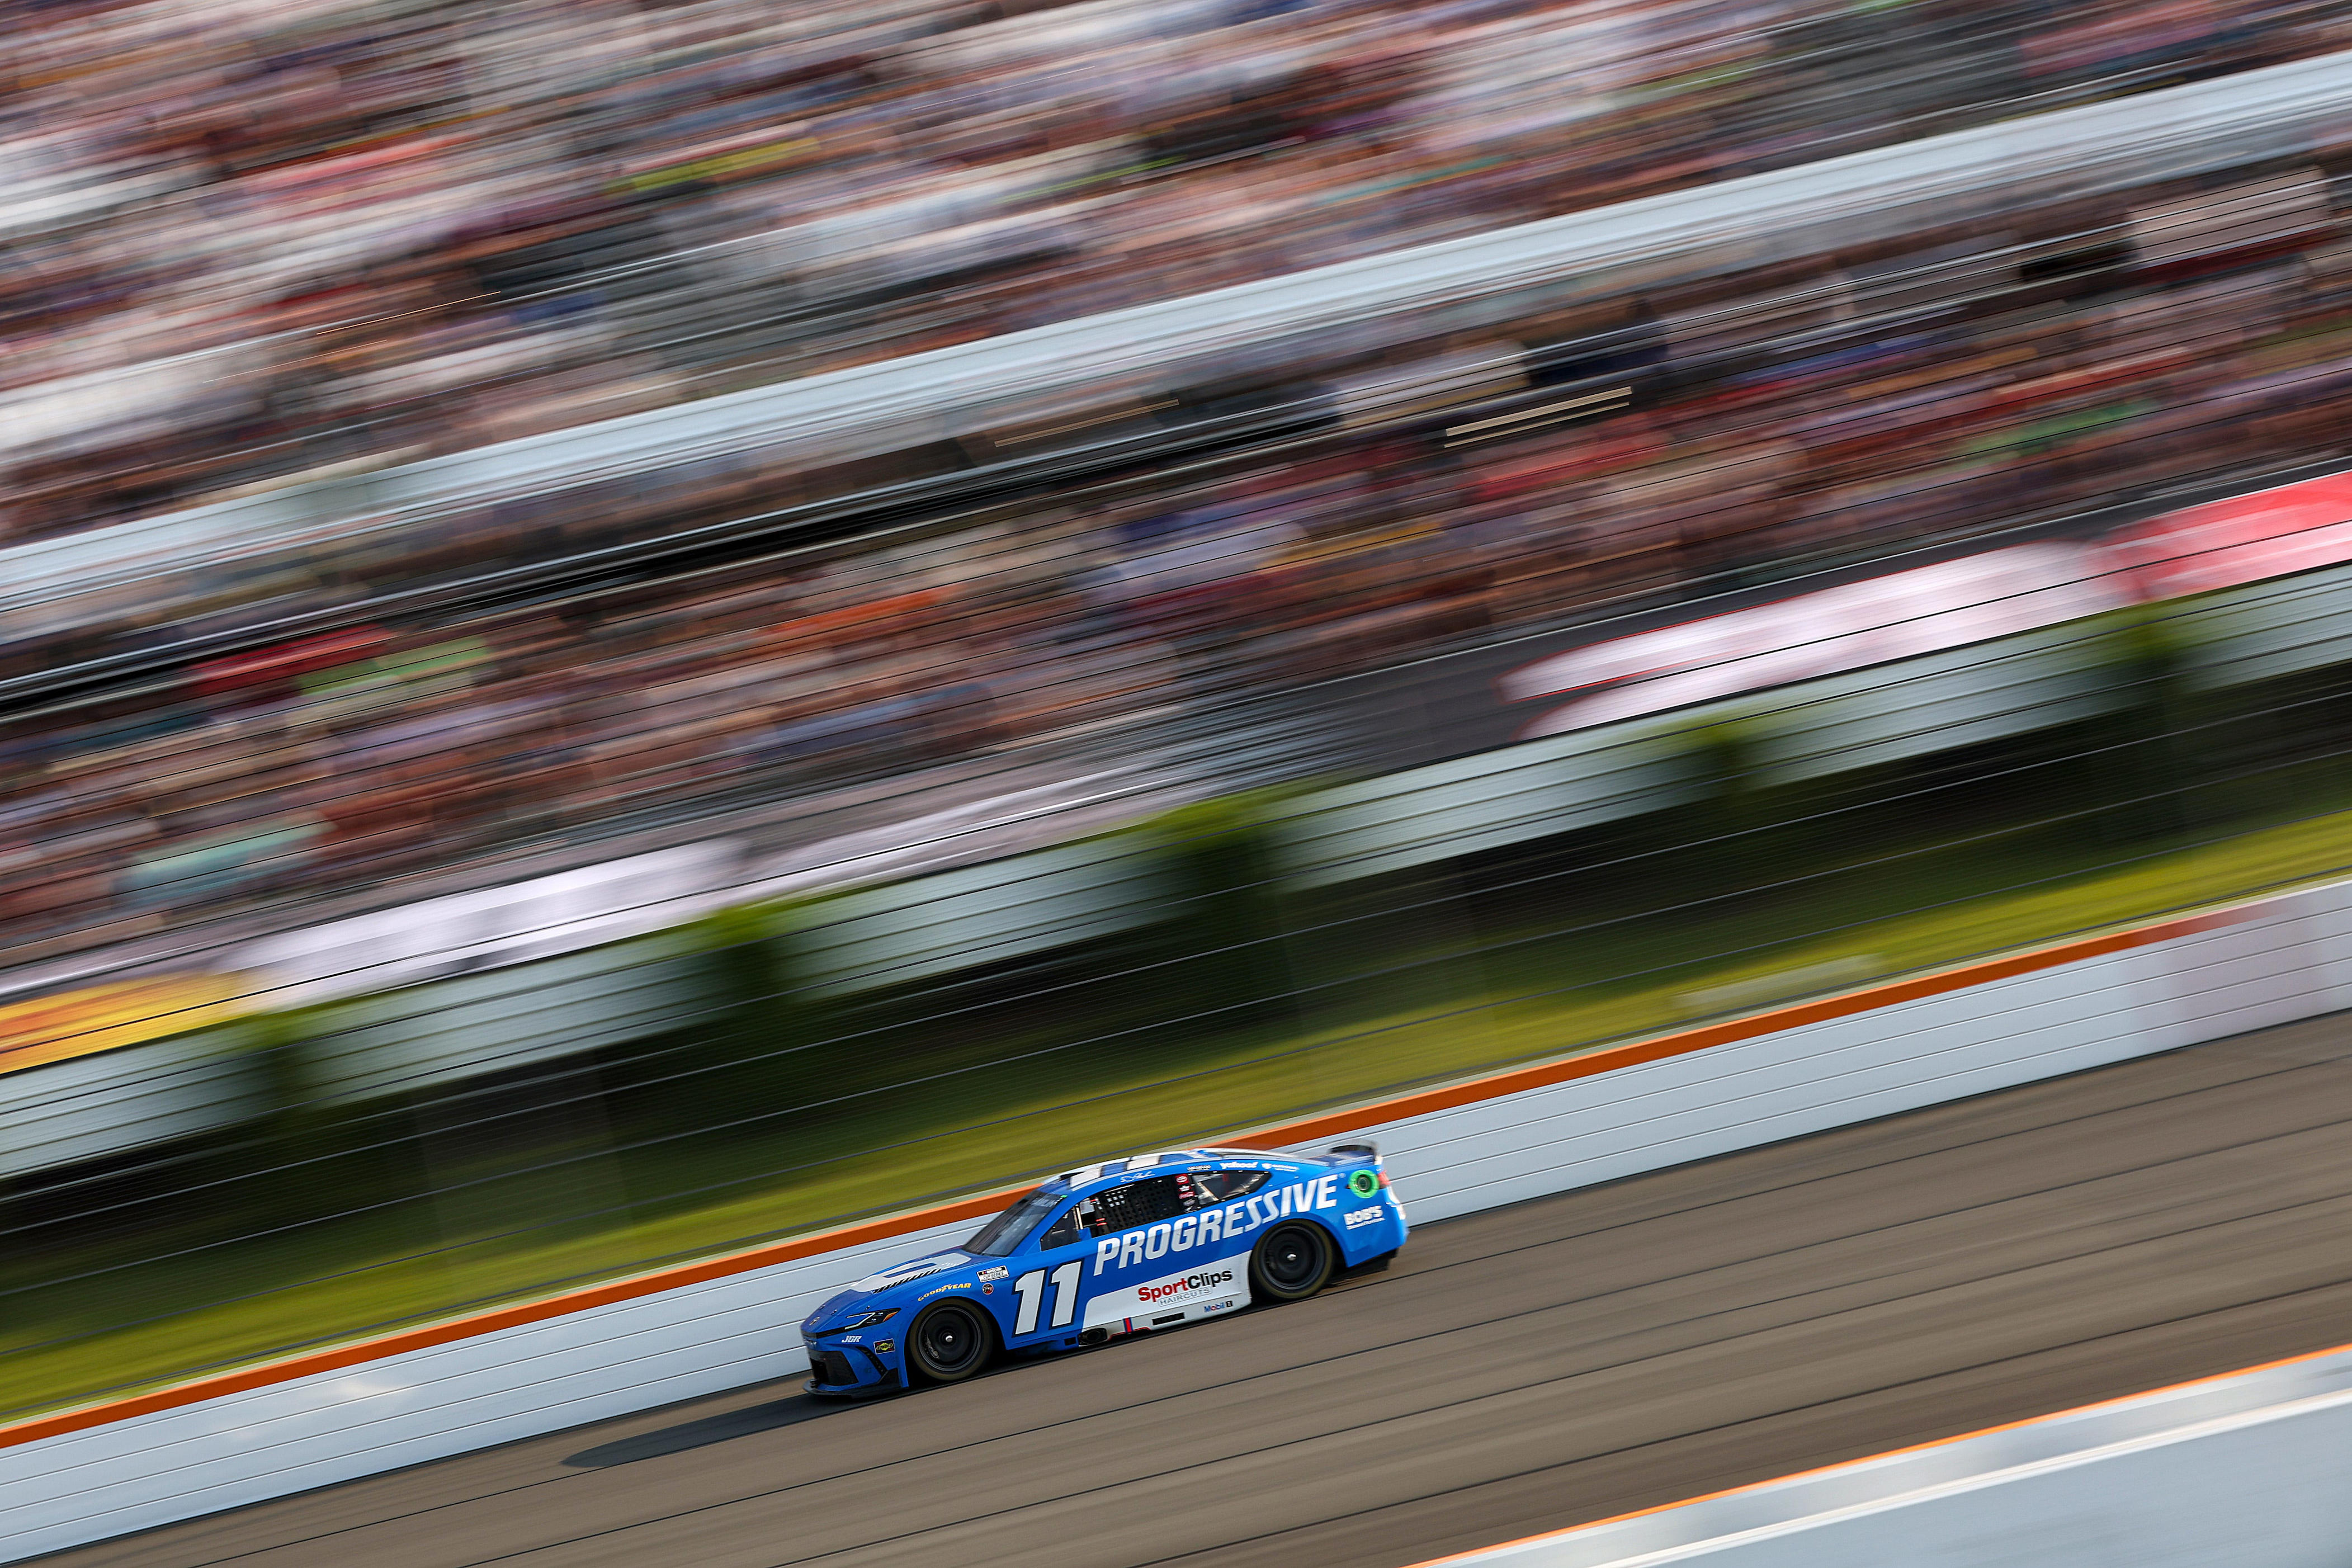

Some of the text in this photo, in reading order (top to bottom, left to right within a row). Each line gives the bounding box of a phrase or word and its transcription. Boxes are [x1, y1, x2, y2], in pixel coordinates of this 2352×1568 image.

[1093, 1174, 1338, 1276] PROGRESSIVE
[918, 1283, 971, 1301] GOODYEAR
[1014, 1260, 1082, 1335] 11
[1160, 1287, 1211, 1306] HAIRCUTS
[1204, 1302, 1225, 1312] Mobil
